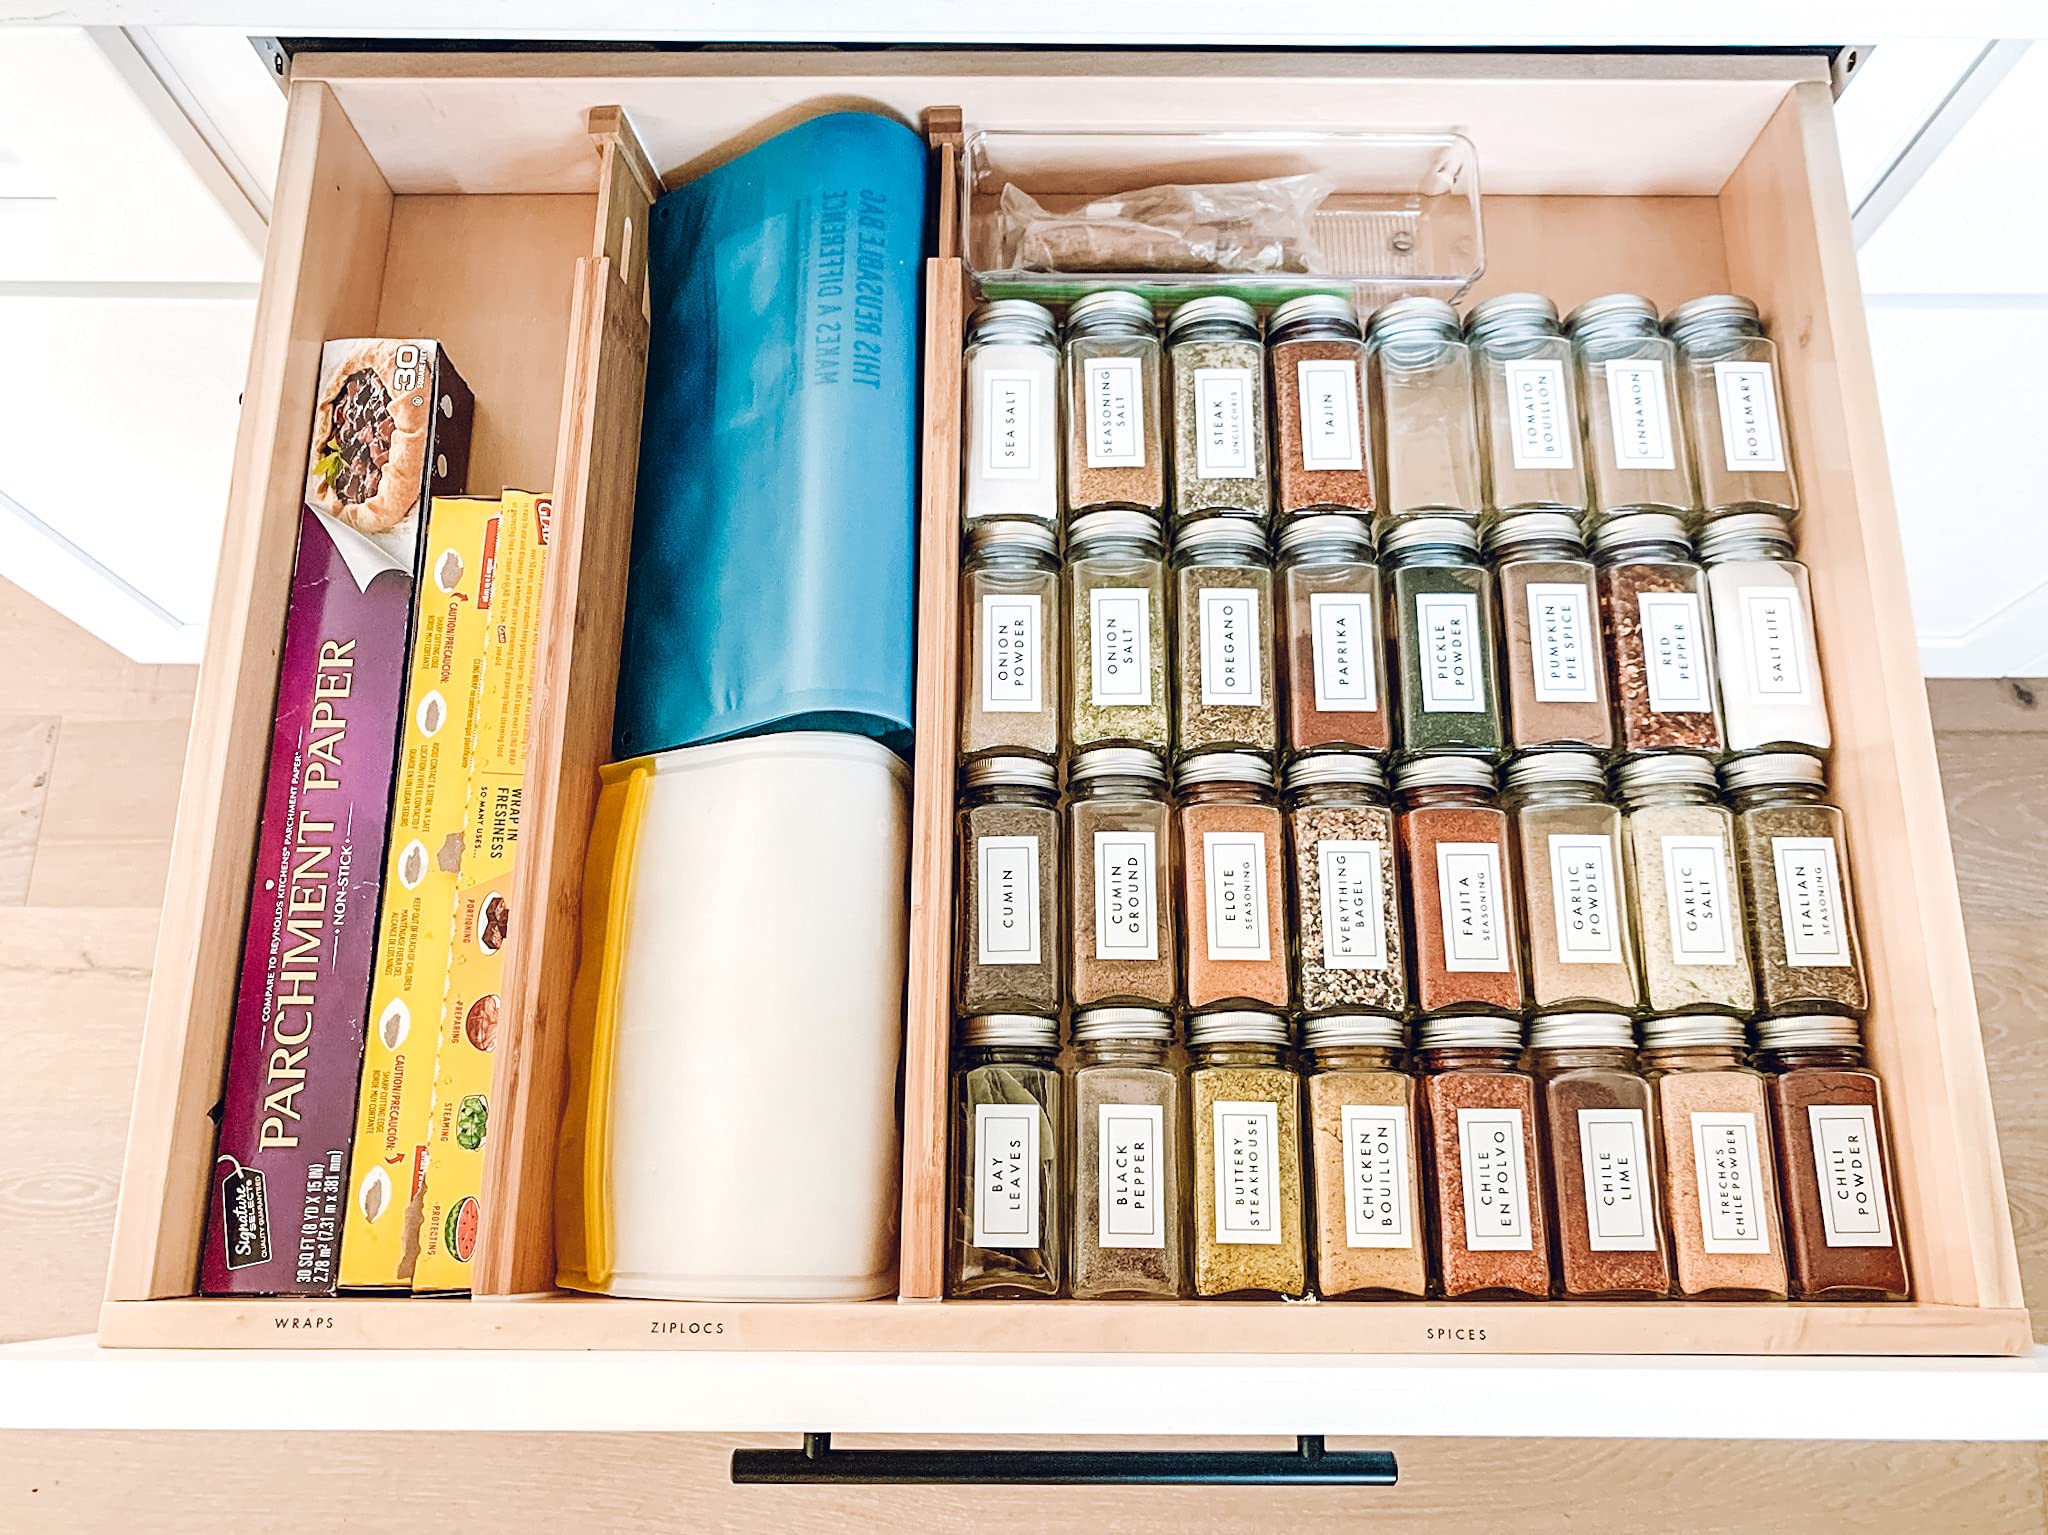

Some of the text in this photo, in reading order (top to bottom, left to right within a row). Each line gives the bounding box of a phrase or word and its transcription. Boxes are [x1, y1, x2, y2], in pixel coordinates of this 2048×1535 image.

[393, 344, 420, 391] 30
[416, 363, 426, 389] SQUARE
[1005, 392, 1015, 457] SEA SALT
[1101, 371, 1112, 453] SEASONING
[1115, 397, 1125, 427] SALT
[1213, 401, 1224, 445] STEAK
[1323, 394, 1335, 435] TAJIN
[1523, 383, 1538, 444] TOMATO
[1532, 376, 1555, 452] BOUILLON
[1631, 374, 1648, 455] CINNAMON
[1739, 376, 1758, 456] ROSEMARY
[998, 625, 1008, 681] ONION
[1014, 620, 1024, 686] POWDER
[1106, 619, 1118, 675] ONION
[1122, 630, 1133, 664] SALT
[1223, 606, 1235, 687] OREGANO
[1336, 618, 1349, 685] PAPRIKA
[1434, 626, 1448, 679] PICKLE
[1450, 619, 1465, 686] POWDER
[1545, 606, 1560, 678] PUMPKIN
[1561, 606, 1577, 679] PIE SPICE
[1660, 637, 1672, 665] RED
[1674, 624, 1689, 679] PEPPER
[1766, 610, 1783, 682] SALT LITE
[426, 758, 438, 783] CONTACT
[479, 785, 487, 798] SO
[284, 786, 297, 845] PARCHMENT
[476, 800, 486, 826] MANY
[490, 786, 508, 858] FRESHNESS
[506, 788, 522, 841] WRAP IN
[259, 639, 356, 1152] PARCHMENT PAPER
[333, 845, 352, 925] NON-STICK
[1002, 870, 1014, 928] CUMIN
[1111, 866, 1123, 924] CUMIN
[1127, 857, 1139, 933] GROUND
[1224, 870, 1236, 921] ELOTE
[1243, 862, 1253, 930] SEASONING
[1336, 856, 1351, 952] EVERYTHING
[1353, 880, 1365, 927] BAGEL
[1459, 877, 1473, 936] FAJITA
[1477, 872, 1490, 941] SEASONING
[1568, 867, 1584, 930] GARLIC
[1585, 862, 1601, 935] POWDER
[1681, 868, 1697, 931] GARLIC
[1699, 882, 1713, 918] SALT
[1795, 867, 1814, 936] ITALIAN
[1814, 867, 1831, 935] SEASONING
[407, 932, 417, 953] REACH
[462, 899, 475, 943] PORTIONING
[267, 955, 278, 970] TO
[262, 972, 275, 1022] COMPARE
[451, 1001, 463, 1044] PREPARING
[365, 1069, 381, 1135] BORDE MUY CORTANTE
[375, 1070, 390, 1134] SHARP CUTTING EDGE
[439, 1102, 452, 1142] STEAMING
[323, 1173, 340, 1193] 381
[327, 1150, 343, 1171] mm)
[992, 1158, 1003, 1192] BAY
[1009, 1140, 1021, 1210] LEAVES
[1116, 1146, 1128, 1205] BLACK
[1134, 1142, 1145, 1209] PEPPER
[1234, 1138, 1245, 1205] BUTTERY
[1247, 1120, 1260, 1226] STEAKHOUSE
[1360, 1134, 1374, 1220] CHICKEN
[1377, 1127, 1392, 1226] BOUILLON
[1478, 1152, 1493, 1206] CHILE
[1493, 1131, 1512, 1226] EN POLVO
[1600, 1153, 1615, 1206] CHILE
[1617, 1158, 1632, 1200] LIME
[1715, 1149, 1730, 1215] TRECHA'S
[1726, 1130, 1746, 1236] CHILE POWDER
[1832, 1151, 1849, 1200] CHILI
[1848, 1133, 1869, 1215] POWDER
[232, 1184, 257, 1255] Signature
[255, 1175, 268, 1257] QUALITY GUARANTEED
[296, 1162, 324, 1283] 30 SQ FT (8 YD X 15 IN)
[323, 1202, 337, 1214] m
[325, 1193, 338, 1202] x
[317, 1216, 336, 1241] (7.31
[427, 1205, 440, 1256] PROTECTING
[313, 1259, 331, 1283] 2.78
[275, 1318, 334, 1329] WRAPS
[651, 1322, 725, 1334] ZIPLOCS
[1427, 1328, 1487, 1340] SPICES
